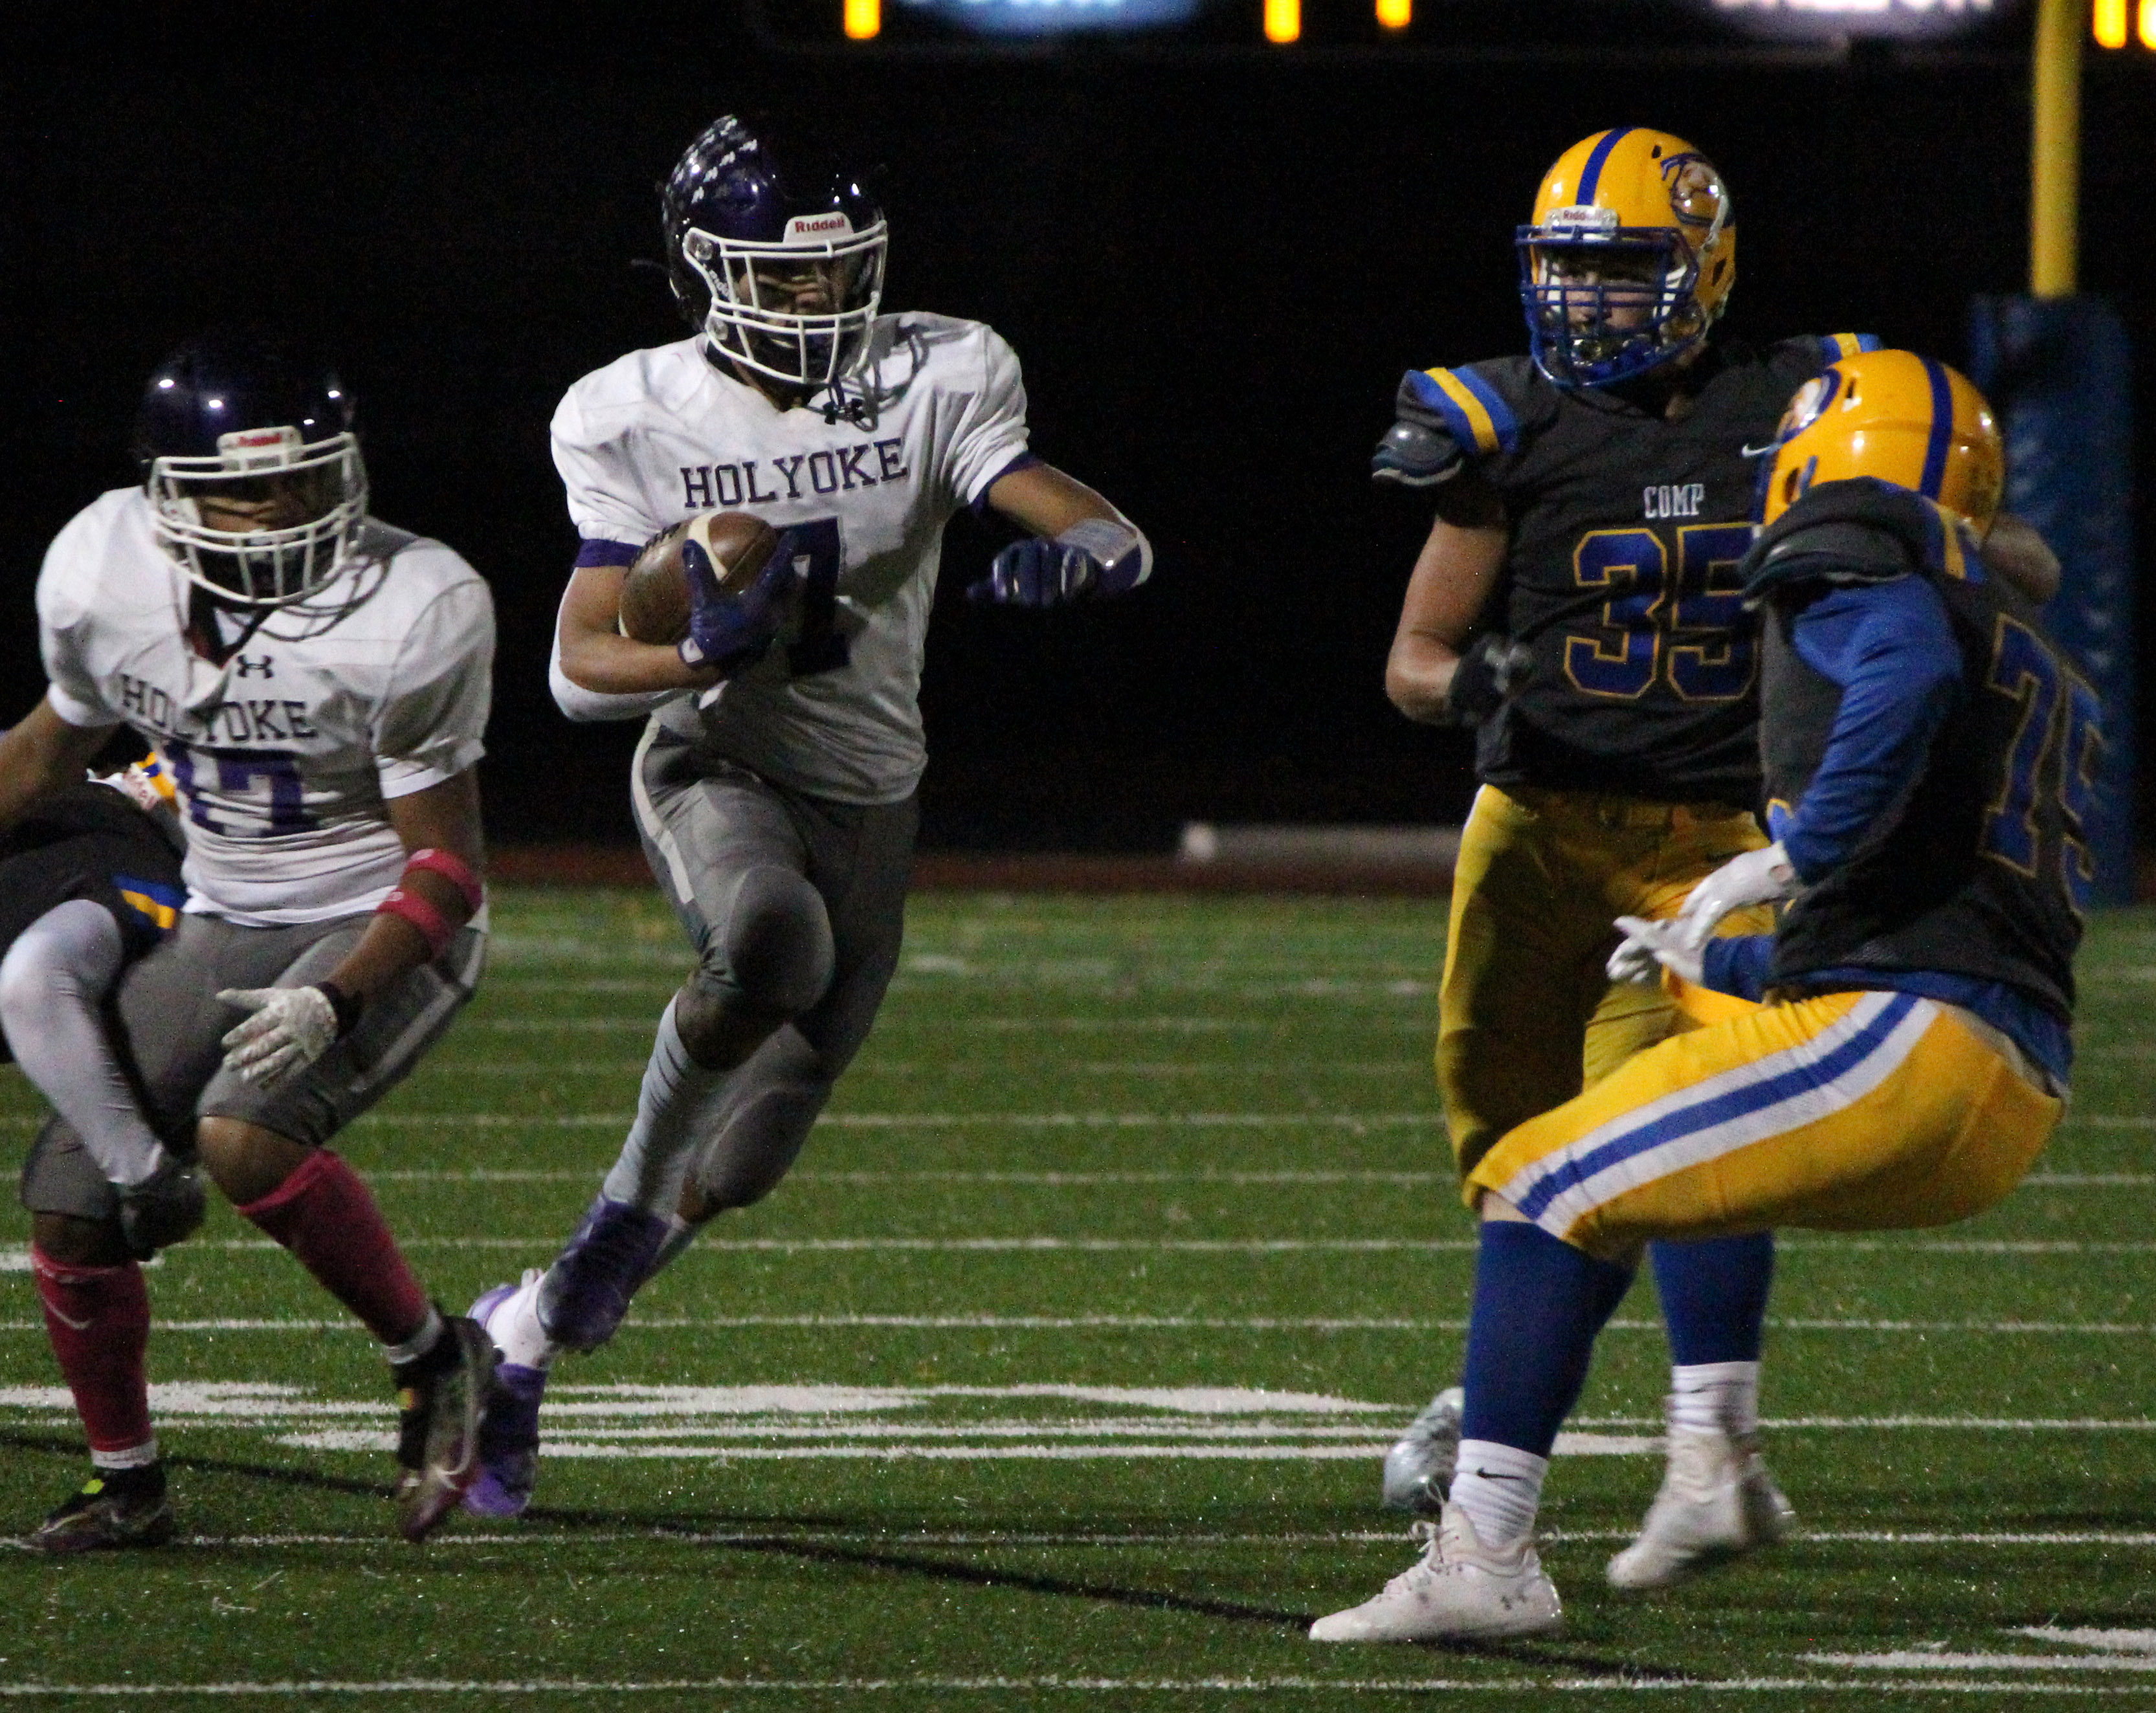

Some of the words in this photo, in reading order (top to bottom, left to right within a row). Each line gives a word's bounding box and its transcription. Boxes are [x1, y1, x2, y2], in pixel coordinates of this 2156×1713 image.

[795, 217, 843, 233] Riddell
[680, 437, 907, 508] HOLYOKE
[1643, 483, 1705, 518] COMP
[1564, 522, 1759, 700] 35
